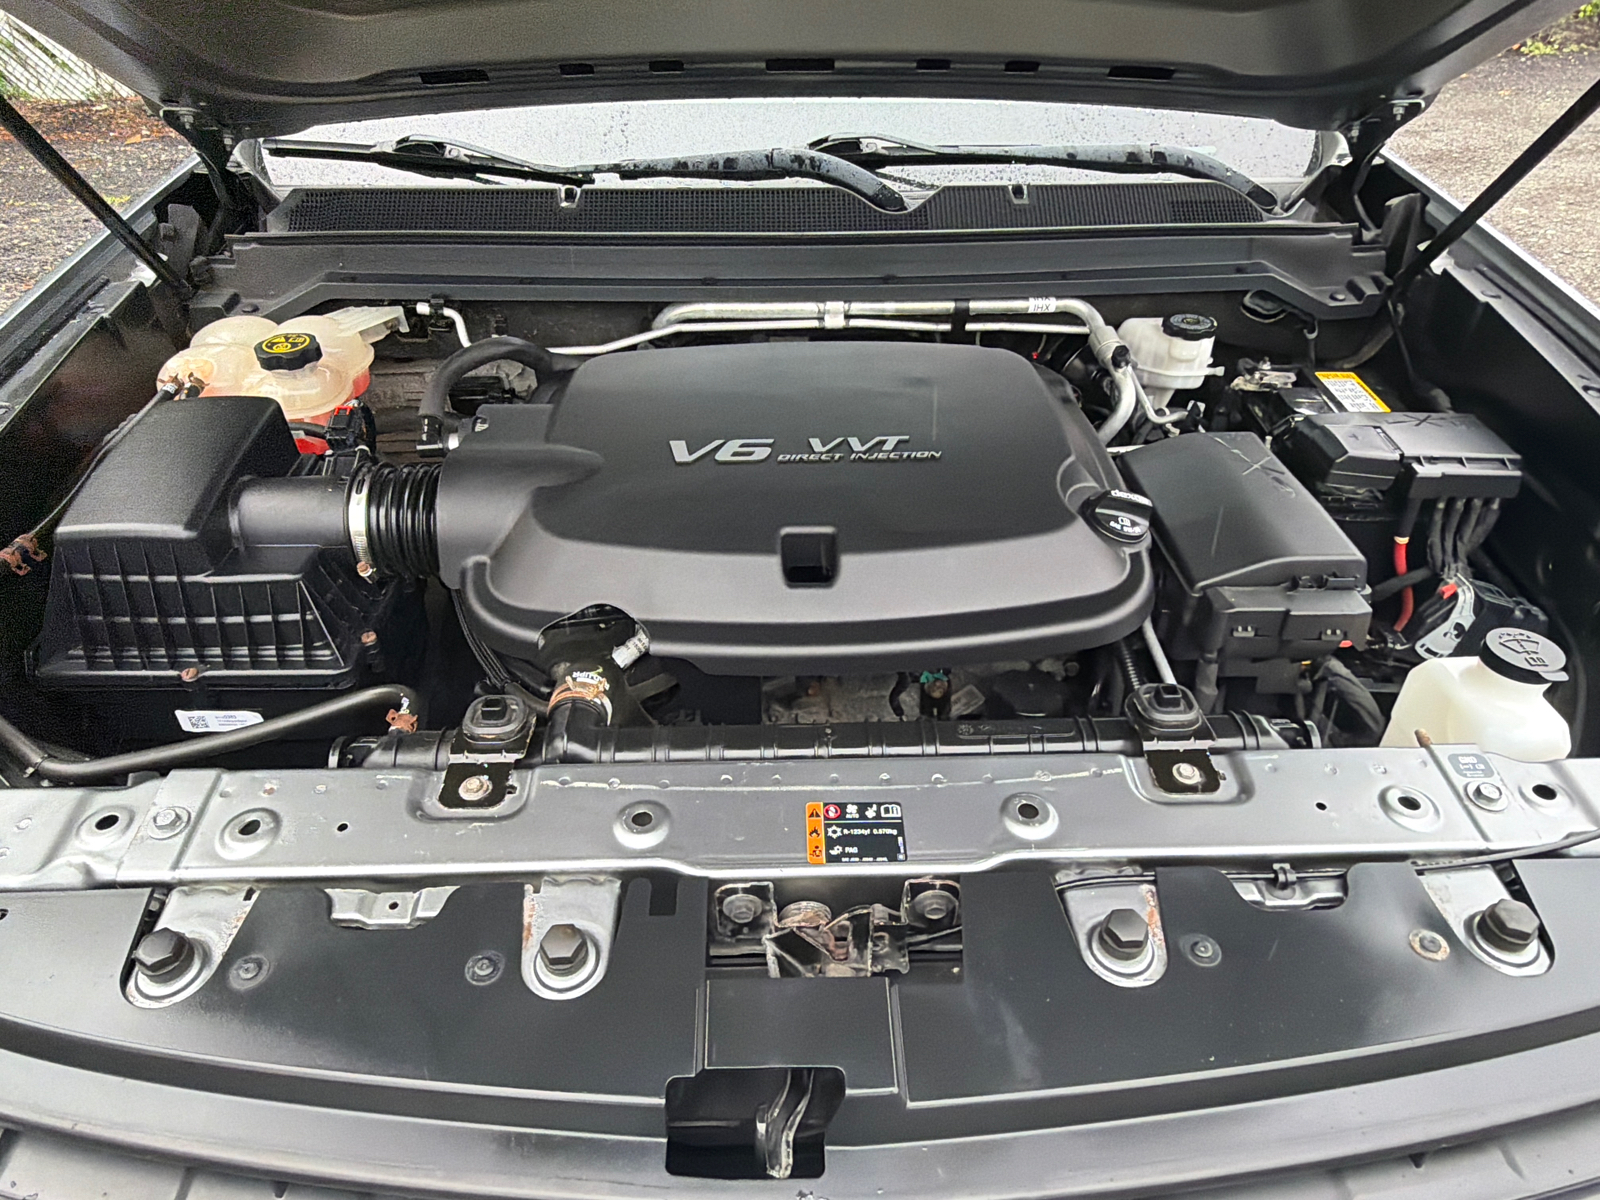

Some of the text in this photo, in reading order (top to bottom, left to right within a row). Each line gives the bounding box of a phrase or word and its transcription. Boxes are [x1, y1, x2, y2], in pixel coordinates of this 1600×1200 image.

[669, 438, 775, 464] V6
[807, 435, 910, 453] VVT
[776, 450, 943, 463] DIRECT INJECTION
[843, 828, 871, 836] R-1234yf
